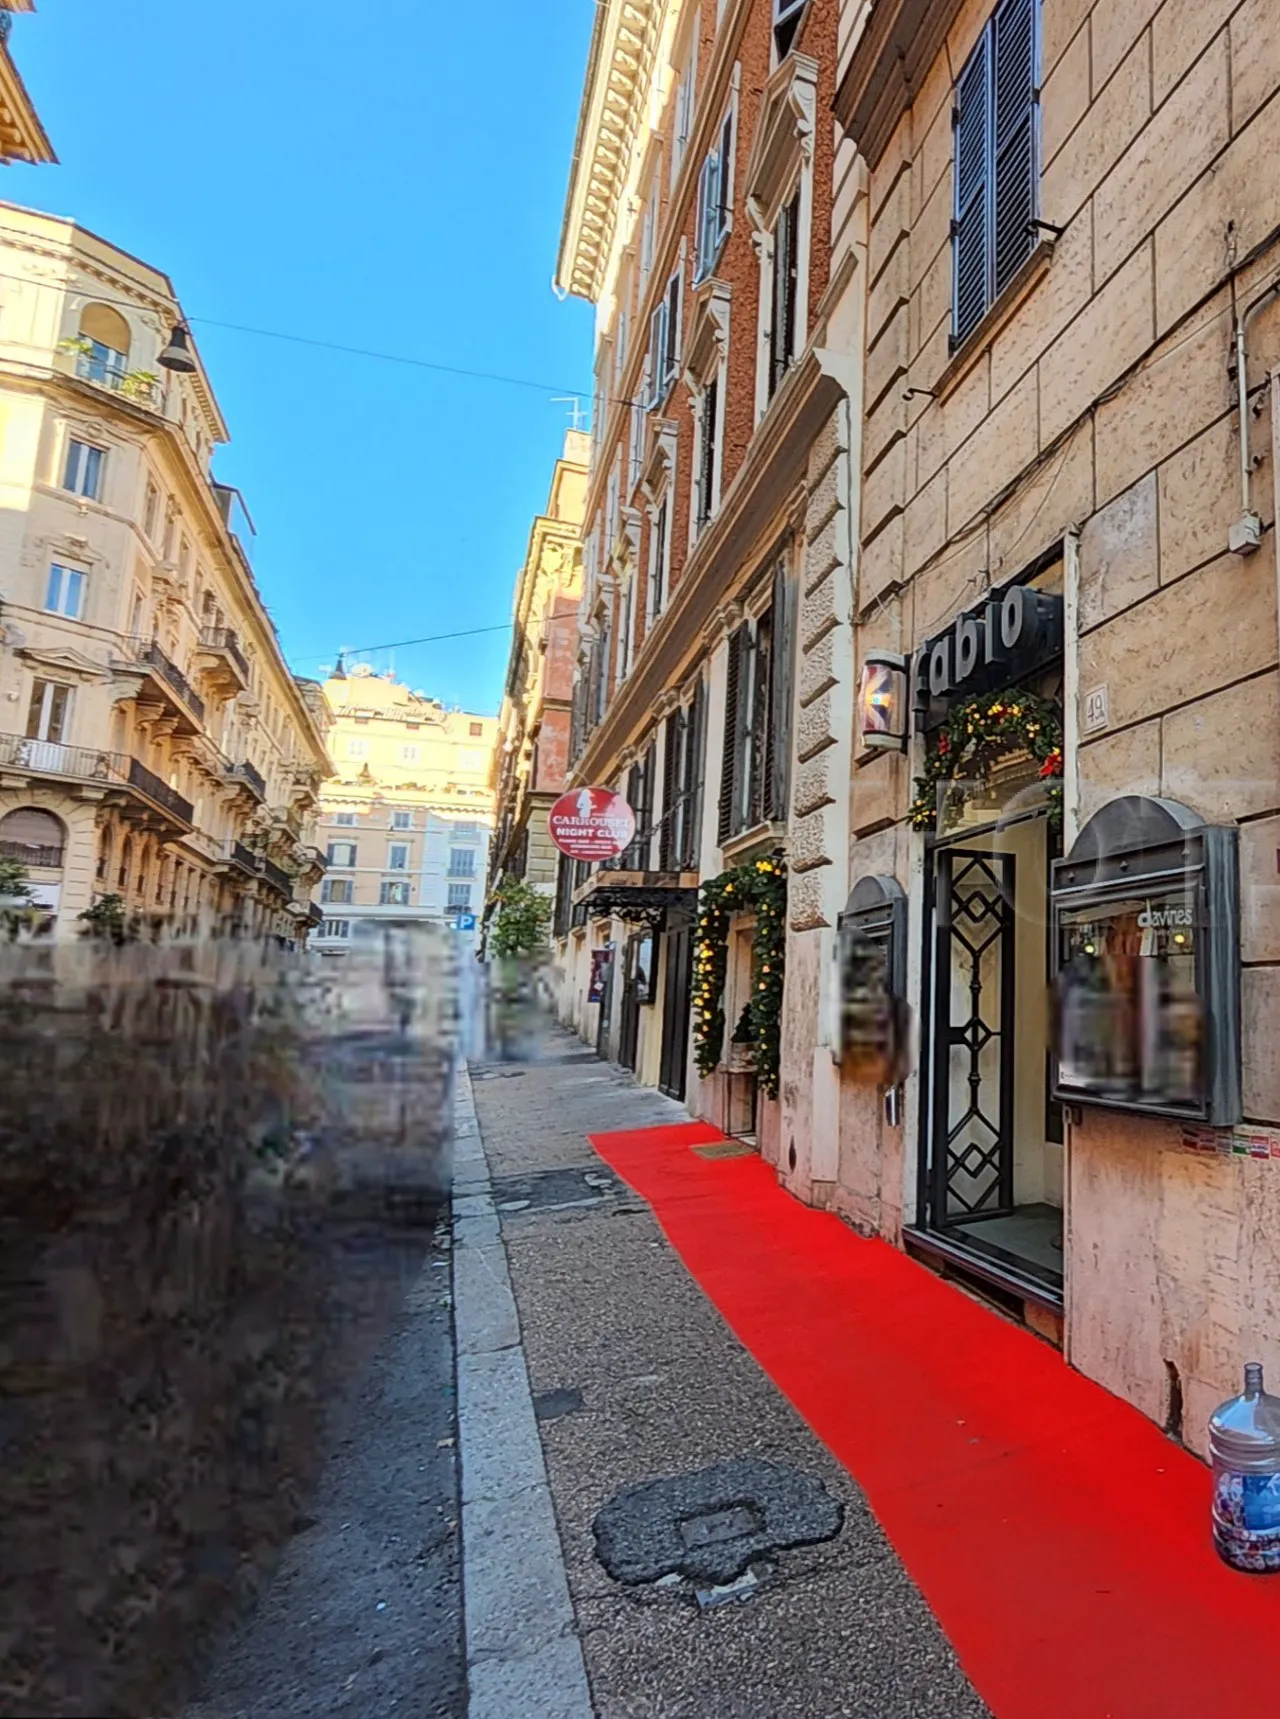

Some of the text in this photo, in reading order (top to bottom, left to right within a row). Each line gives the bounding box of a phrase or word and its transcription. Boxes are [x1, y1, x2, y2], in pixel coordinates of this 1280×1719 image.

[556, 827, 629, 839] NIGHT CLUB
[1137, 898, 1193, 928] davines
